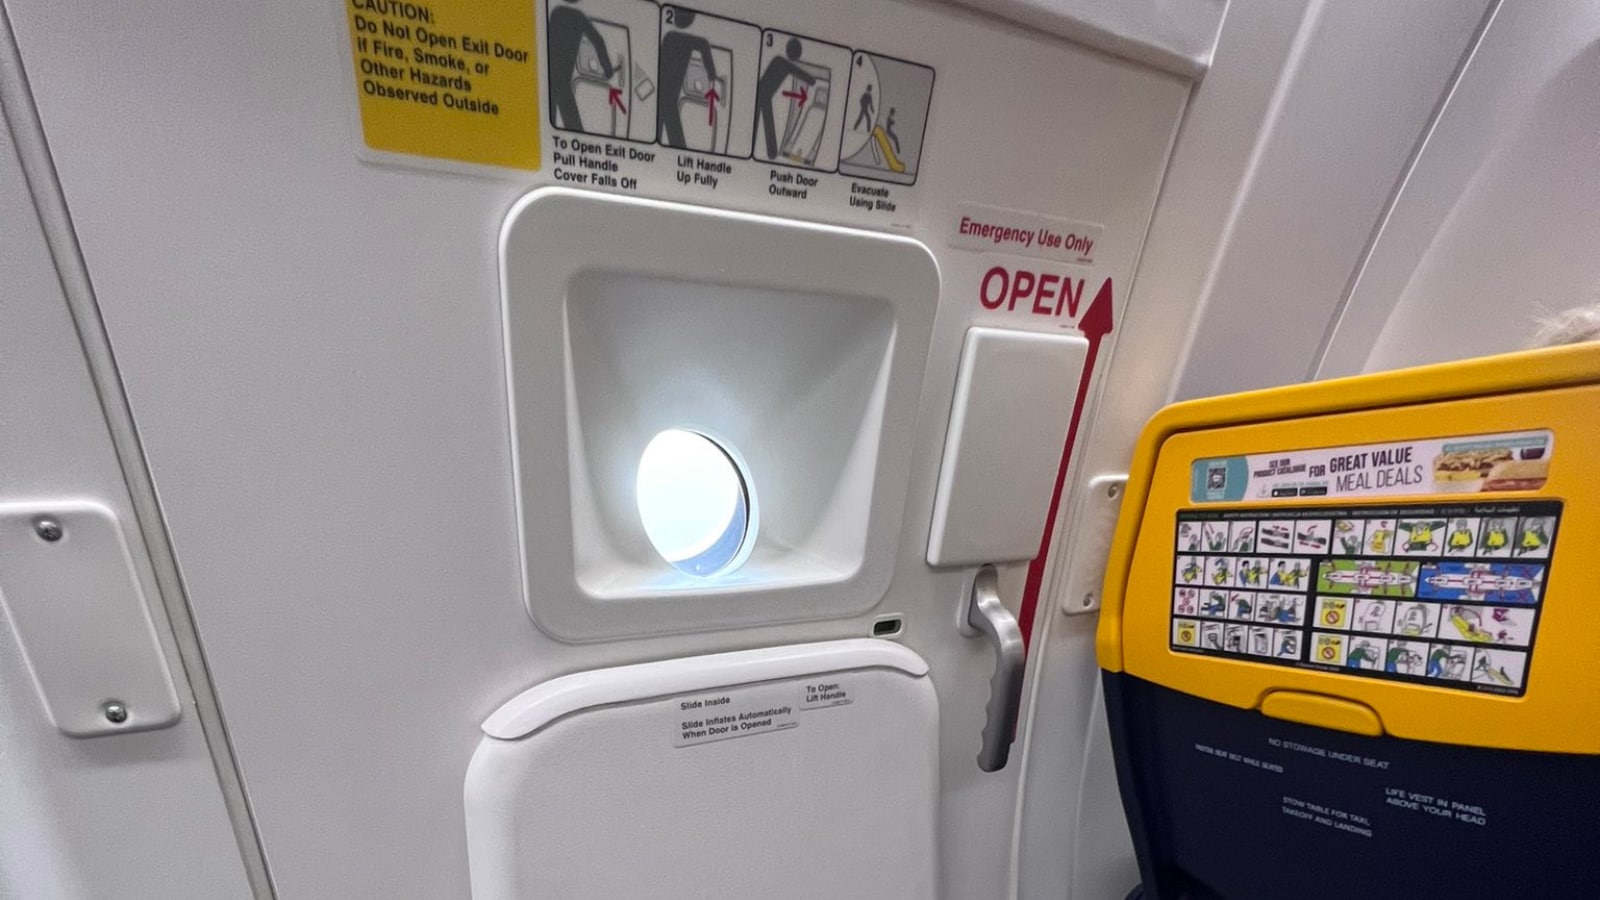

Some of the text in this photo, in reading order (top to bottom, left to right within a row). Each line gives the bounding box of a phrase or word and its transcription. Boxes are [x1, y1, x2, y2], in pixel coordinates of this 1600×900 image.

[352, 0, 434, 24] CAUTION:
[666, 9, 673, 24] 2
[354, 15, 528, 63] Do Not Open Exit Door
[766, 33, 773, 47] 3
[373, 40, 408, 62] Fire,
[414, 47, 470, 74] Smoke,
[475, 62, 490, 76] or
[856, 54, 862, 67] 4
[361, 58, 472, 92] Other Hazards
[363, 80, 500, 115] Observed Outside
[552, 135, 656, 162] To Open Exit Door
[553, 152, 618, 172] Pull Handle
[677, 155, 732, 174] Lift Handle
[554, 167, 637, 190] Cover Falls Off
[677, 171, 718, 189] Up Fully
[770, 169, 818, 187] Push Door
[769, 184, 807, 200] Outward
[851, 182, 889, 198] Evacuate
[850, 194, 896, 212] Using Slide
[959, 216, 1094, 256] Emergency Use Only
[980, 266, 1085, 318] OPEN
[1329, 446, 1413, 473] GREAT VALUE
[1309, 465, 1326, 478] FOR
[1336, 464, 1424, 493] MEAL DEALS
[806, 685, 816, 693] To
[806, 691, 846, 703] Lift Handle
[680, 697, 731, 711] Slide Inside
[681, 706, 792, 730] Slide Inflates Automatically
[682, 729, 707, 740] When
[709, 725, 729, 736] Door
[731, 723, 738, 732] is
[740, 719, 772, 731] Opened
[1268, 737, 1281, 747] NO
[1328, 750, 1361, 764] UNDER
[1363, 757, 1390, 769] SEAT
[1307, 802, 1329, 815] TABLE
[1331, 809, 1348, 819] FOR
[1385, 788, 1486, 816] LIFE VEST IN PANEL
[1386, 797, 1486, 825] ABOVE YOUR HEAD
[1315, 816, 1333, 826] AND
[1334, 821, 1373, 837] LANDING
